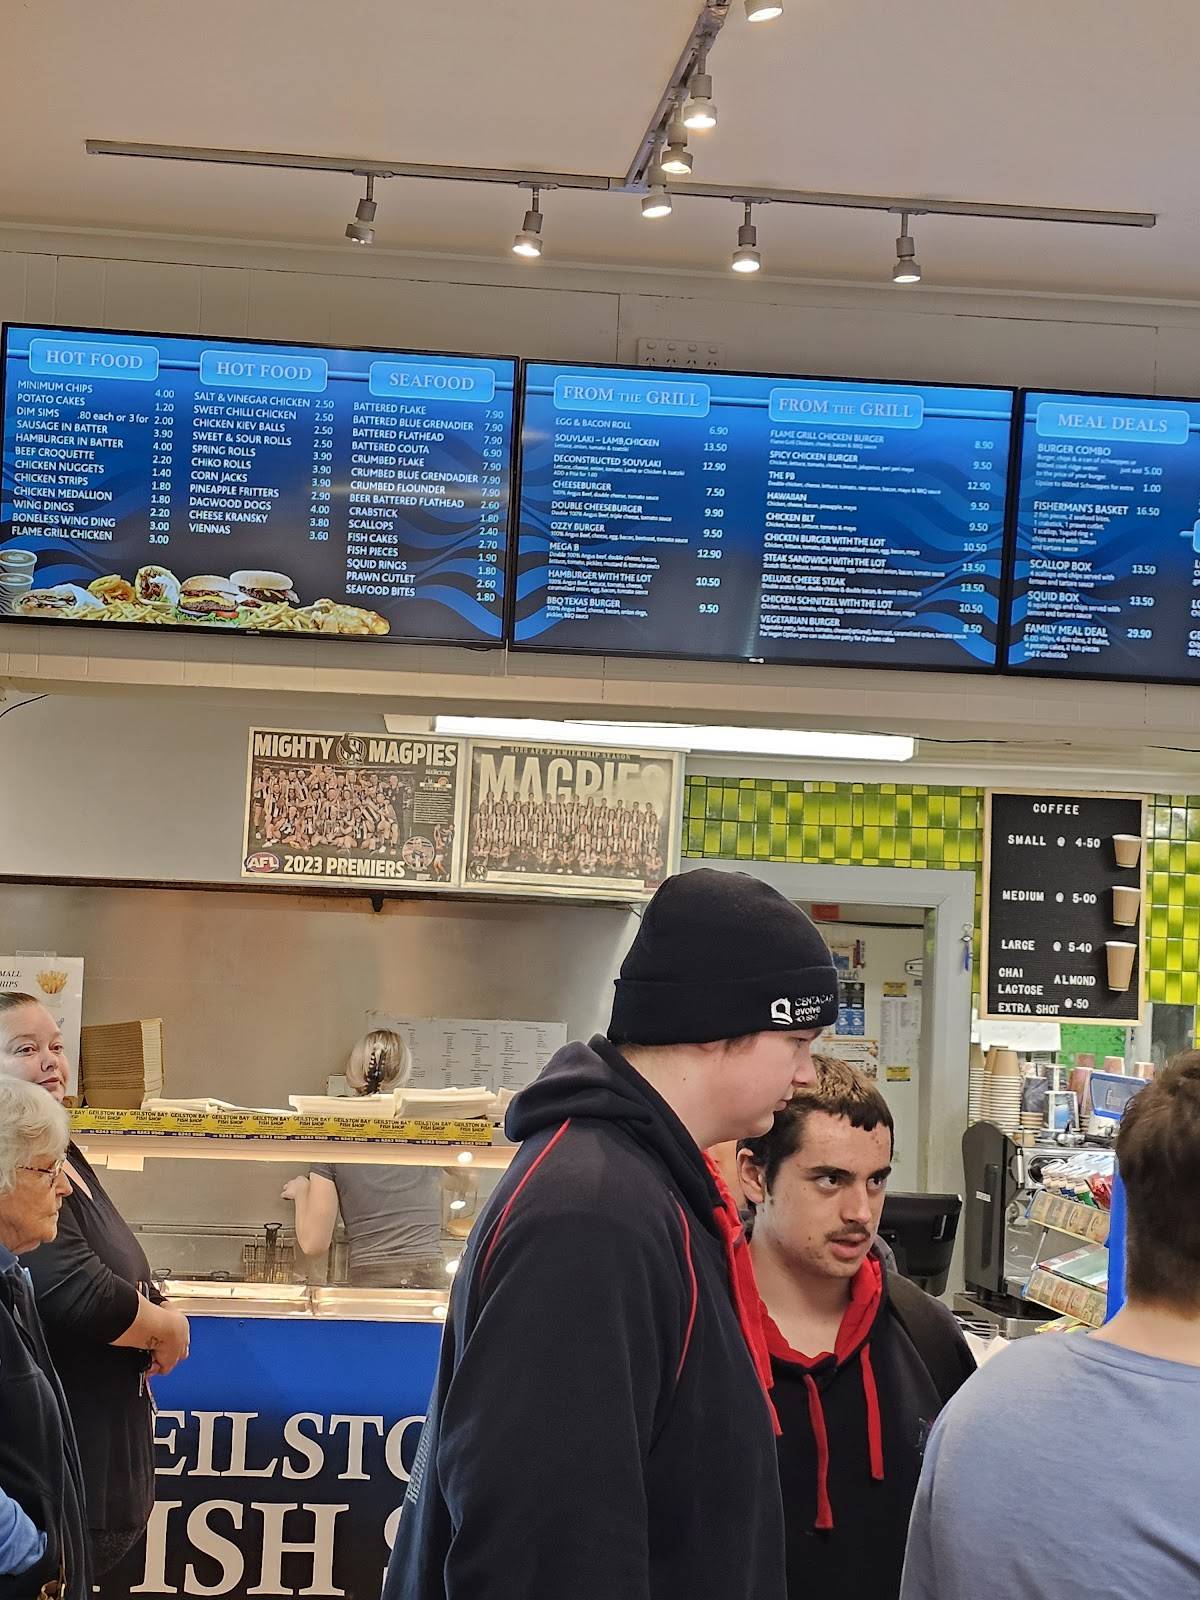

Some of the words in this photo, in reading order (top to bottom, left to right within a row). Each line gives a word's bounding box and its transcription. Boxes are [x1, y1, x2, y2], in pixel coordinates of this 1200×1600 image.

[46, 350, 88, 367] HOT
[90, 354, 143, 369] FOOD
[217, 361, 255, 376] HOT
[261, 365, 312, 380] FOOD
[18, 380, 63, 392] MINIMUM
[65, 383, 93, 393] CHIPS
[155, 389, 175, 399] 4.00
[389, 373, 474, 391] SEAFOOD
[17, 394, 55, 405] POTATO
[56, 396, 85, 405] CAKES
[155, 403, 174, 412] 1.20
[194, 392, 216, 401] SALT
[217, 393, 225, 402] &
[227, 394, 268, 404] VINEGAR
[269, 396, 311, 407] CHICKEN
[315, 400, 334, 408] 2.50
[563, 386, 614, 401] FROM
[619, 392, 641, 402] THE
[646, 391, 700, 406] GRILL
[16, 407, 35, 416] DIM
[38, 408, 59, 418] SIMS
[77, 411, 91, 420] .80
[93, 412, 114, 421] each
[117, 414, 126, 422] or
[129, 414, 135, 422] 3
[136, 414, 149, 423] for
[154, 416, 173, 425] 2.00
[193, 405, 223, 415] SWEET
[226, 407, 254, 416] CHILLI
[255, 409, 297, 420] CHICKEN
[315, 413, 333, 421] 2.50
[354, 402, 397, 413] BATTERED
[400, 405, 426, 415] FLAKE
[485, 410, 503, 419] 7.90
[779, 398, 828, 413] FROM
[833, 405, 856, 415] THE
[860, 402, 914, 418] GRILL
[16, 420, 59, 431] SAUSAGE
[61, 422, 72, 432] IN
[74, 423, 108, 434] BATTER
[153, 429, 172, 438] 3.90
[353, 415, 397, 426] BATTERED
[399, 418, 421, 428] BLUE
[423, 419, 474, 431] GRENADIER
[484, 423, 503, 432] 7.90
[556, 418, 572, 426] EGG
[582, 419, 610, 428] BACON
[612, 421, 631, 429] ROLL
[709, 426, 728, 435] 6.90
[1058, 414, 1106, 429] MEAL
[1112, 417, 1168, 432] DEALS
[191, 445, 226, 455] SPRING
[228, 447, 256, 456] ROLLS
[313, 452, 332, 461] 3.90
[1038, 443, 1074, 454] BURGER
[1075, 446, 1111, 456] COMBO
[14, 460, 55, 471] CHICKEN
[58, 462, 104, 473] NUGGETS
[152, 469, 171, 478] 1.40
[554, 454, 621, 465] DECONSTRUCTED
[622, 458, 662, 468] SOUVLAKI
[702, 462, 726, 471] 12.90
[1144, 467, 1162, 475] 5.00
[14, 473, 55, 485] CHICKEN
[58, 476, 88, 486] STRIPS
[151, 482, 170, 491] 1.80
[191, 471, 218, 481] CORN
[220, 473, 248, 483] JACKS
[312, 479, 330, 487] 3.90
[351, 467, 395, 479] CRUMBED
[397, 469, 419, 480] BLUE
[421, 471, 478, 483] GRENDADIER
[482, 476, 500, 485] 7.90
[553, 480, 612, 491] CHEESEBURGER
[706, 488, 725, 497] 7.50
[13, 499, 41, 510] WING
[42, 501, 74, 512] DINGS
[150, 509, 169, 518] 2.20
[189, 497, 242, 508] DAGWOOD
[244, 500, 271, 511] DOGS
[311, 505, 330, 514] 4.00
[189, 511, 223, 521] CHEESE
[225, 512, 268, 523] KRANSKY
[310, 518, 329, 527] 3.80
[349, 507, 398, 518] CRABSTICK
[480, 514, 499, 523] 1.80
[189, 524, 231, 534] VIENNAS
[309, 532, 328, 540] 3.60
[551, 522, 573, 531] OZZY
[574, 523, 605, 532] BURGER
[703, 529, 722, 538] 9.50
[348, 533, 368, 542] FISH
[369, 534, 398, 544] CAKES
[478, 540, 497, 549] 2.70
[254, 733, 334, 759] MIGHTY
[369, 740, 457, 766] MAGPIES
[1033, 804, 1079, 815] COFFEE
[1008, 835, 1046, 846] SMALL
[1057, 837, 1065, 846] @
[250, 857, 279, 868] AFL
[283, 856, 323, 873] 2023
[327, 858, 405, 878] PREMIERS
[1002, 890, 1044, 901] MEDIUM
[1056, 893, 1064, 903] @
[1002, 940, 1035, 951] LARGE
[1053, 942, 1061, 951] @
[999, 968, 1023, 978] CHAI
[1054, 975, 1096, 986] ALMOND
[998, 985, 1043, 995] LACTOSE
[998, 1003, 1031, 1013] EXTRA
[1036, 1004, 1060, 1014] SHOT
[153, 1410, 427, 1481] EILSTO
[130, 1500, 349, 1597] ISH
